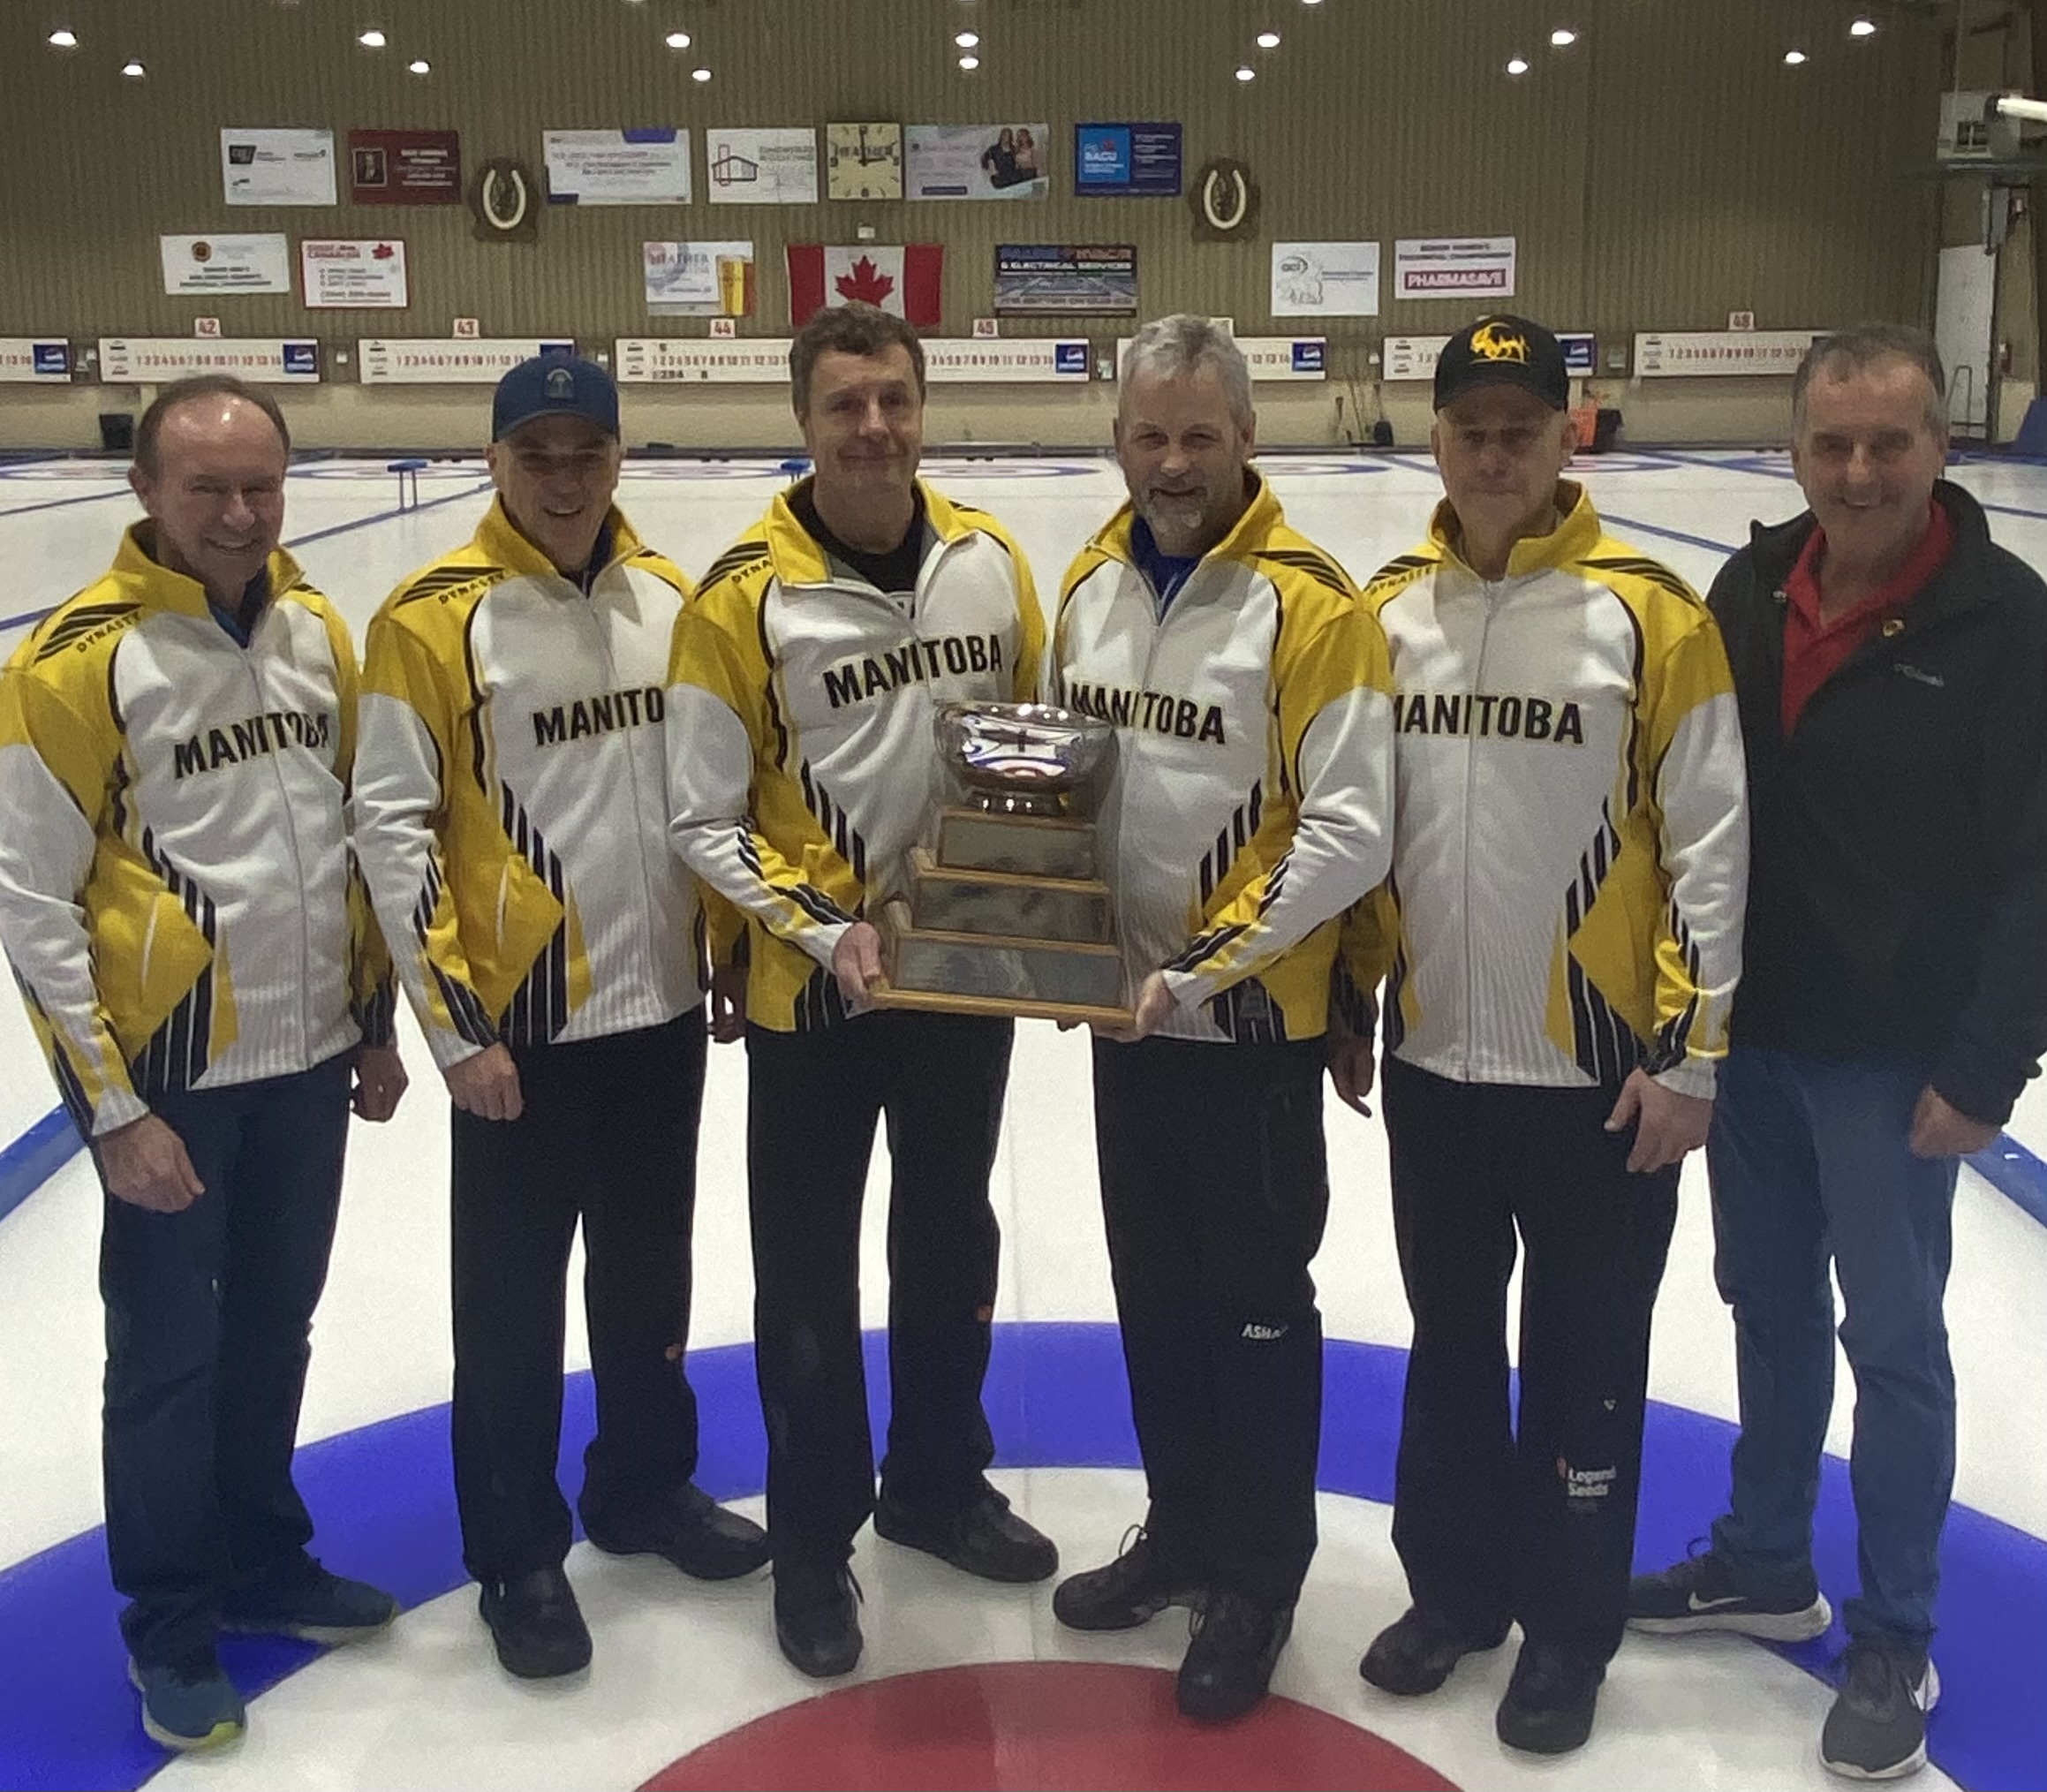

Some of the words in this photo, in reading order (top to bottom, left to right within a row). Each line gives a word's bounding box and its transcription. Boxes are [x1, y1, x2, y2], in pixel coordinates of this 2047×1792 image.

[199, 320, 216, 334] 42
[457, 321, 475, 336] 43
[715, 321, 731, 334] 44
[977, 321, 994, 334] 45
[822, 634, 1001, 708] MANITOBA
[533, 686, 665, 745] MANITO
[1070, 682, 1226, 745] MANITOBA
[173, 712, 330, 779] MANITOBA
